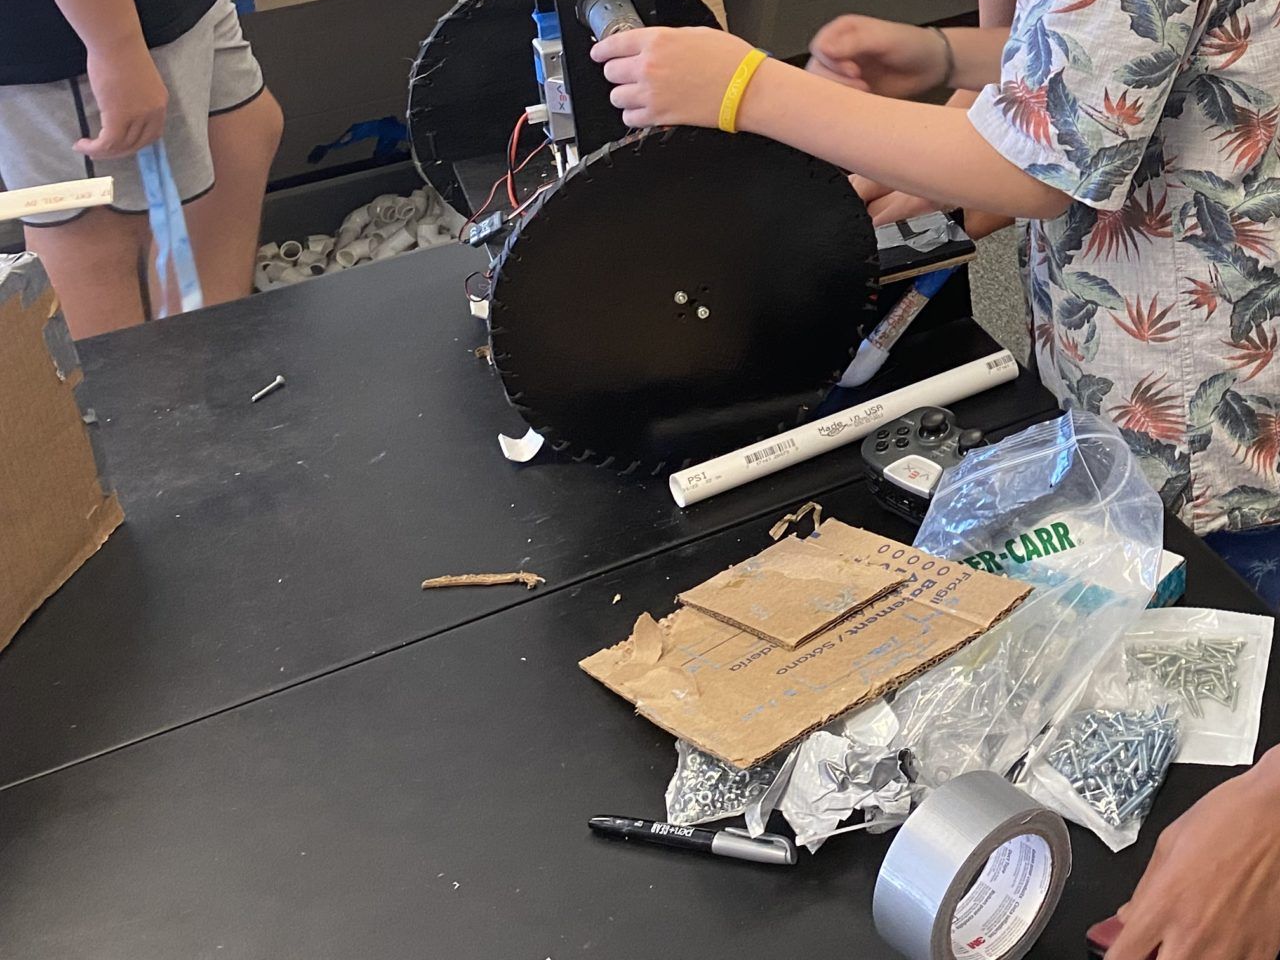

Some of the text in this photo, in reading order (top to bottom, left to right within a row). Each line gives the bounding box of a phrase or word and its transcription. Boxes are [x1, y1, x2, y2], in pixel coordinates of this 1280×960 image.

[818, 421, 844, 433] Made
[849, 415, 860, 423] in
[864, 404, 884, 416] USA
[687, 471, 707, 485] PSI
[958, 521, 1076, 574] ER-CARR
[966, 936, 986, 950] 3M
